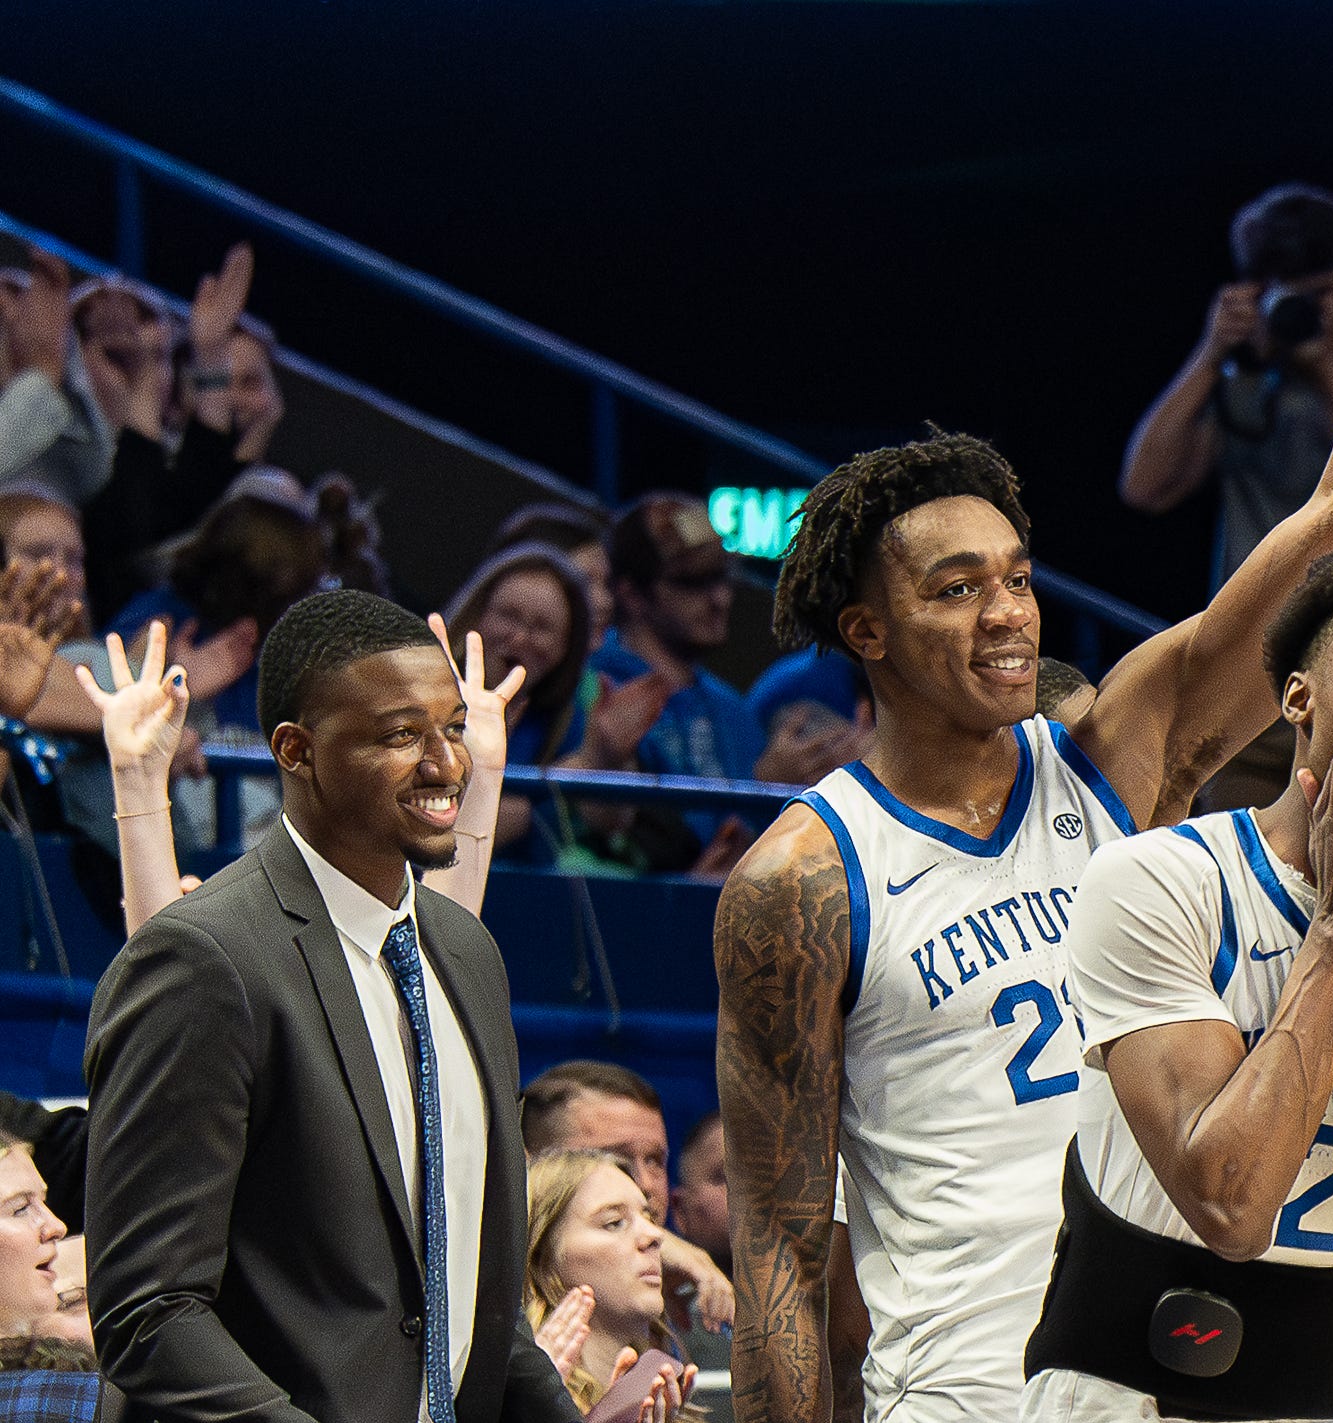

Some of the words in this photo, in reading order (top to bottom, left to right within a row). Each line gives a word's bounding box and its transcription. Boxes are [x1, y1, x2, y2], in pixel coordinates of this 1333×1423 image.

[1053, 813, 1083, 840] SEC
[911, 886, 1081, 1011] KENTUC
[991, 979, 1086, 1106] 2
